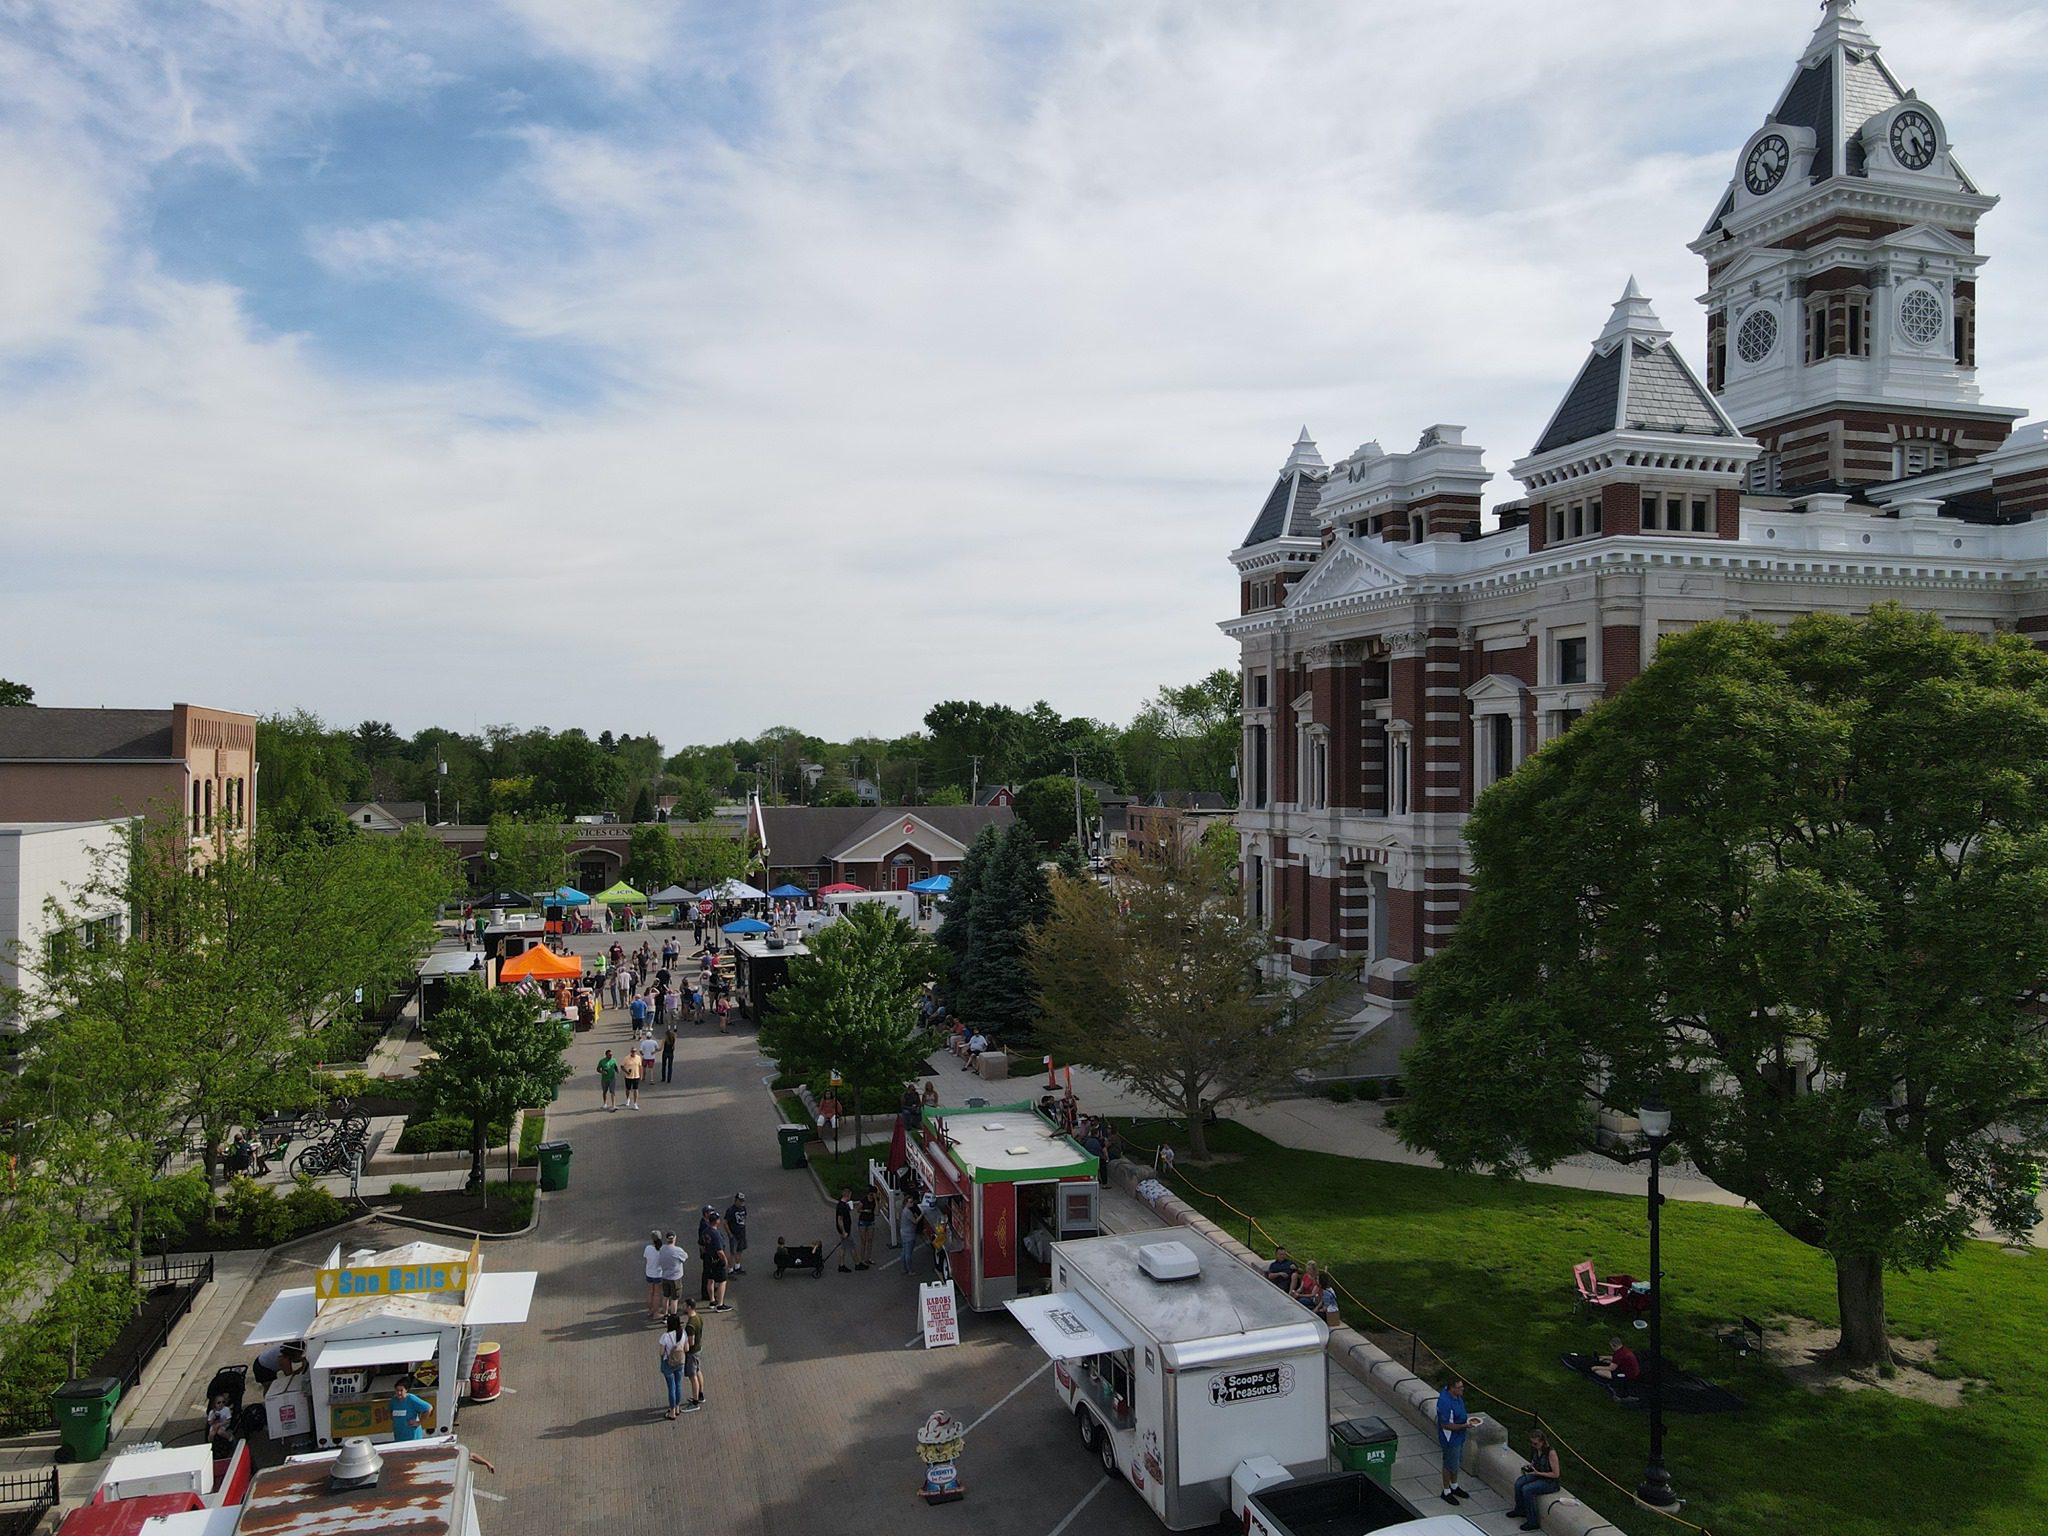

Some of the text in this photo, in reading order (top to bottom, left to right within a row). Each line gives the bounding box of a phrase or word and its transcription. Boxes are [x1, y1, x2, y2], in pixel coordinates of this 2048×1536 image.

[561, 828, 634, 837] SVICES CEN
[338, 1266, 446, 1295] Sno Balls
[336, 1377, 353, 1385] Sno
[1228, 1372, 1276, 1386] Scoops &
[1228, 1383, 1277, 1399] Treasures
